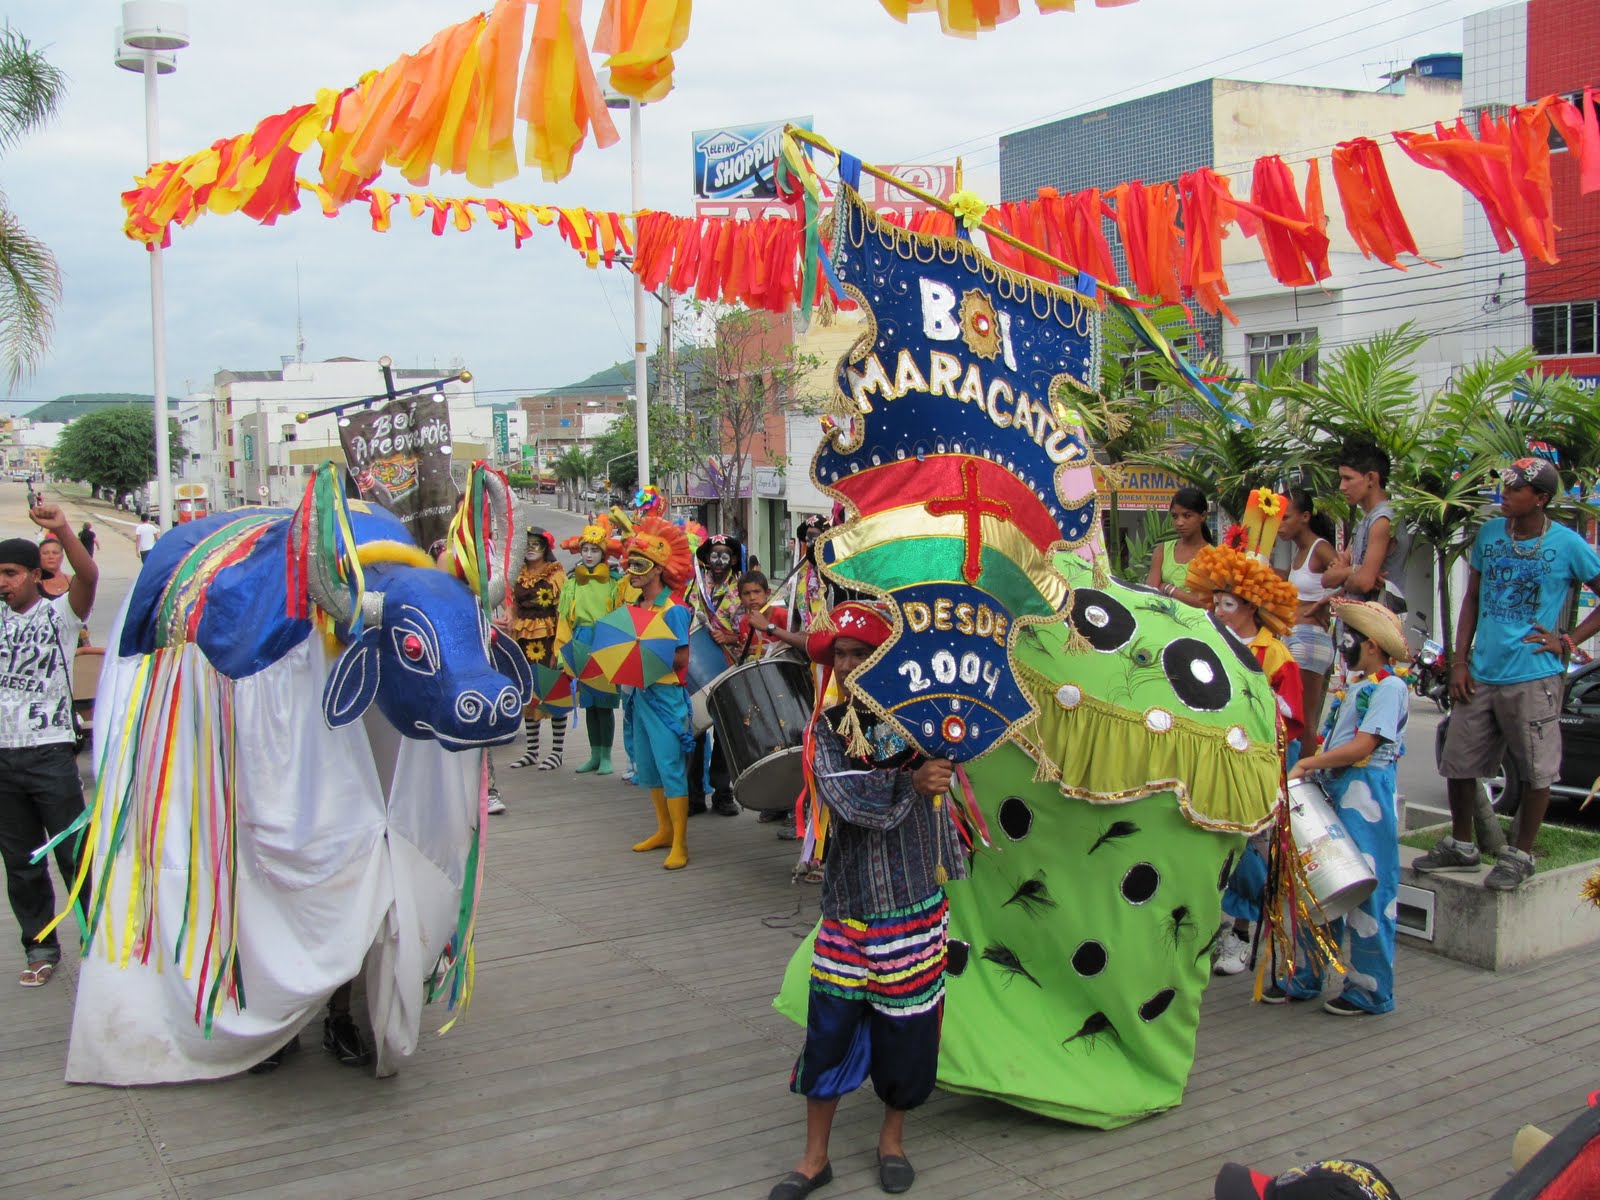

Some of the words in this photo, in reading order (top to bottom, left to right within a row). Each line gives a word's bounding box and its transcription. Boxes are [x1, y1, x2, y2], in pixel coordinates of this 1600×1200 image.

[709, 141, 737, 155] ELETRO
[714, 131, 792, 188] SHOPPIN
[919, 276, 1018, 373] BOI
[373, 402, 417, 438] Boi
[847, 348, 1081, 464] MARACATU
[902, 597, 1009, 648] DESDE
[897, 648, 1001, 700] 2004
